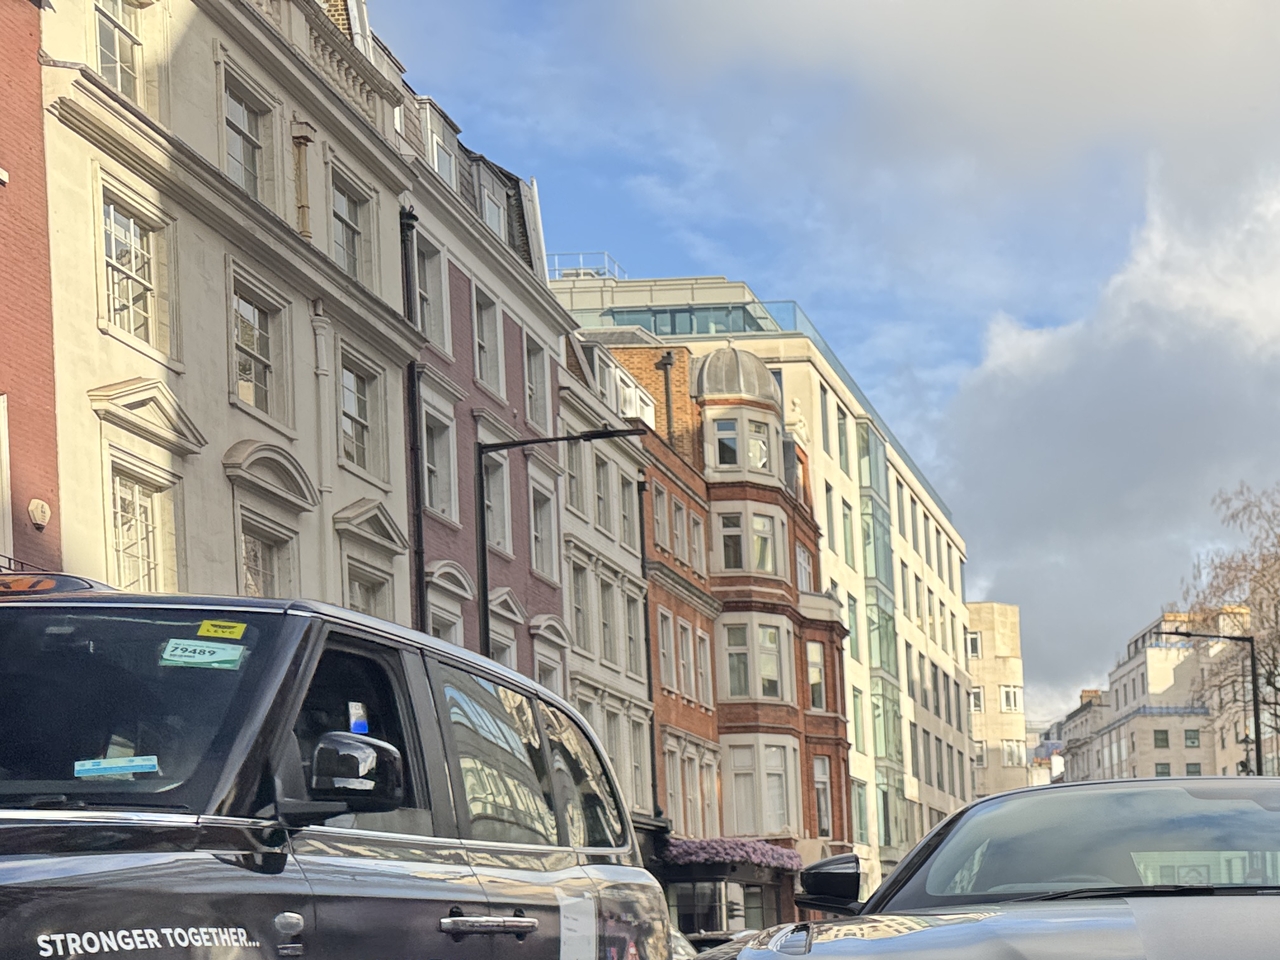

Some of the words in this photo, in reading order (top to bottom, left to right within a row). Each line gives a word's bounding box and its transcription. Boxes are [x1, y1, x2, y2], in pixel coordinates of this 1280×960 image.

[170, 646, 216, 656] 79489
[37, 928, 162, 958] STRONGER
[161, 927, 260, 949] TOGETHER...
